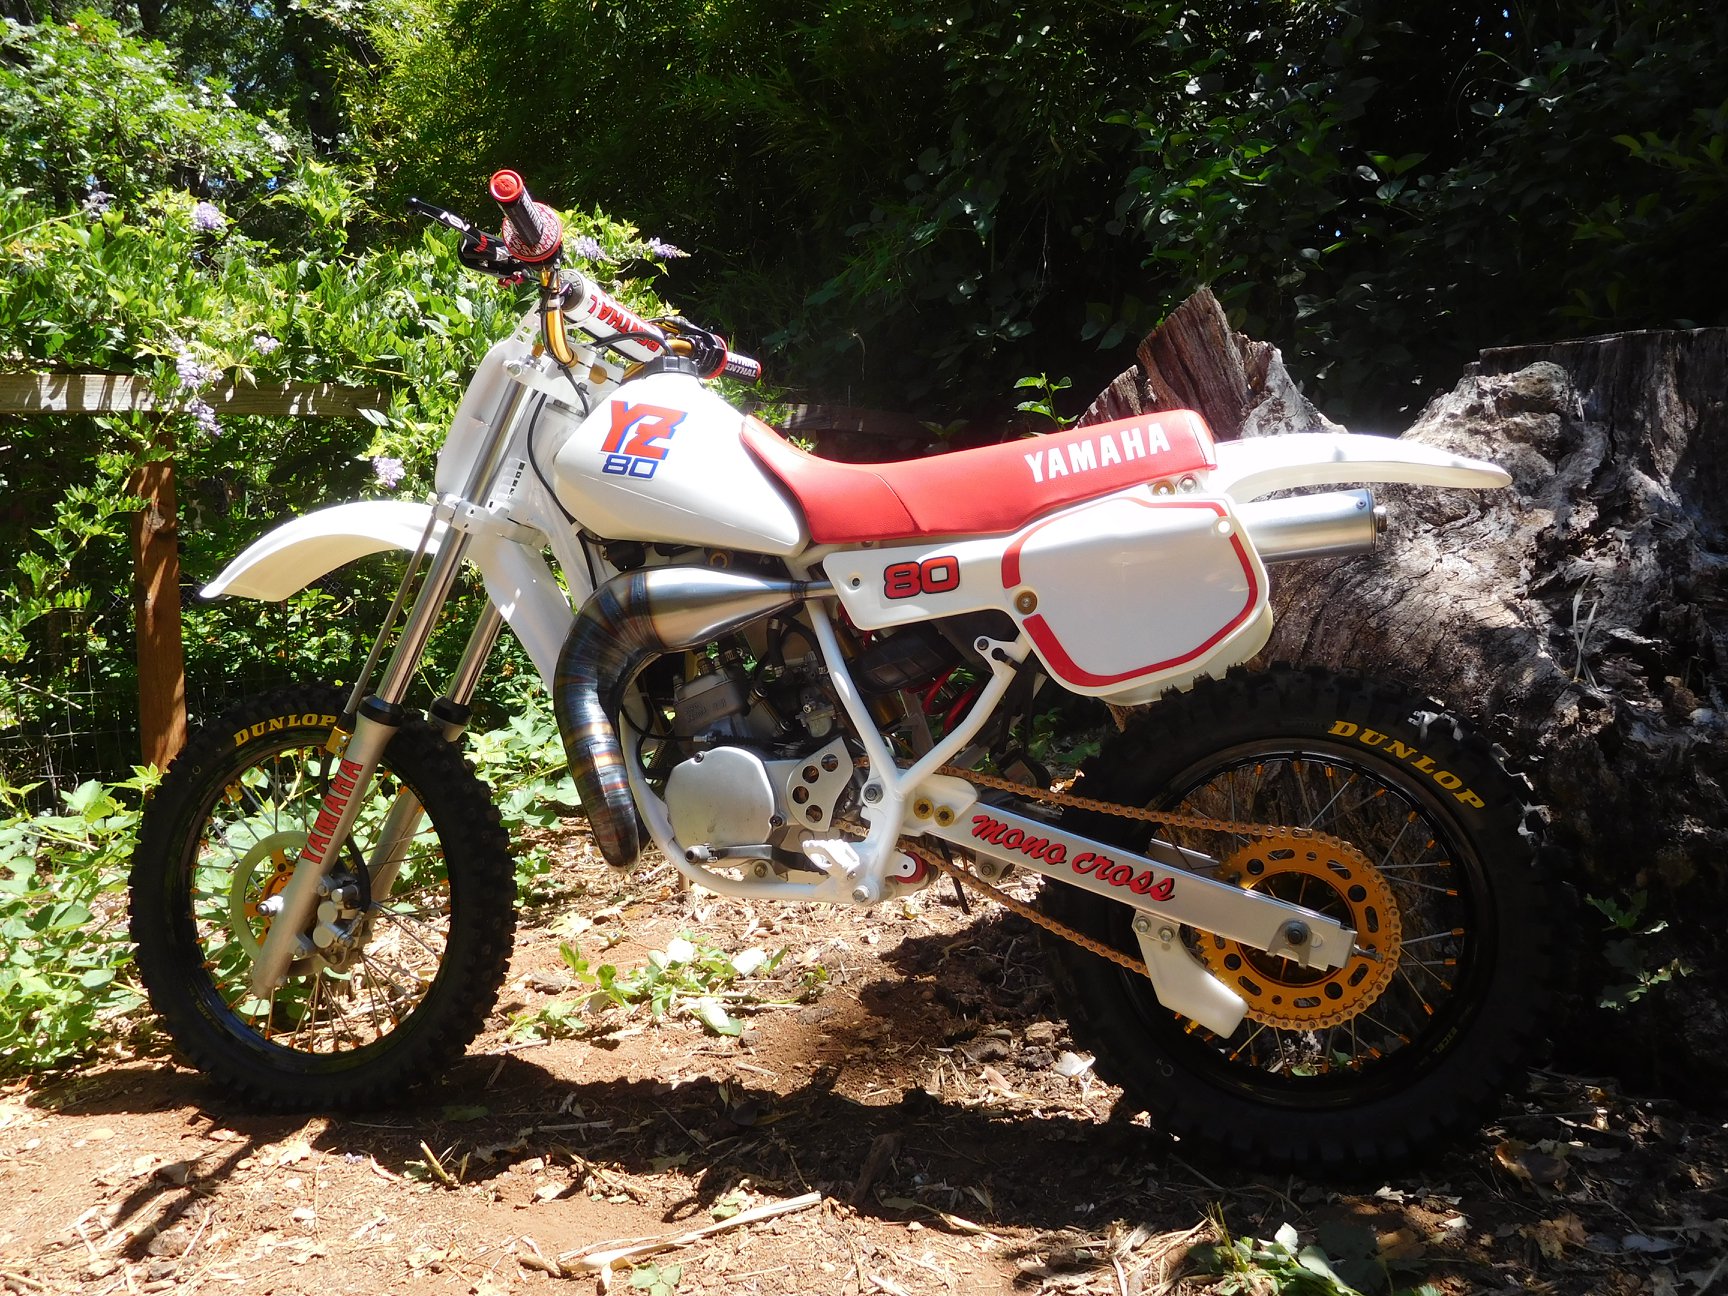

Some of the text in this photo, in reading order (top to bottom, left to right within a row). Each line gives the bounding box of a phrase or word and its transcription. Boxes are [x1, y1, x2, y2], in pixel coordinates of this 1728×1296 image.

[725, 363, 757, 378] ENTHAL
[601, 399, 689, 461] YZ
[1024, 421, 1172, 484] YAMAHA
[601, 454, 660, 480] 80
[882, 554, 961, 600] 80
[233, 713, 337, 747] DUNLOP
[1327, 720, 1486, 810] DUNLOP
[300, 759, 364, 865] YAMAHA
